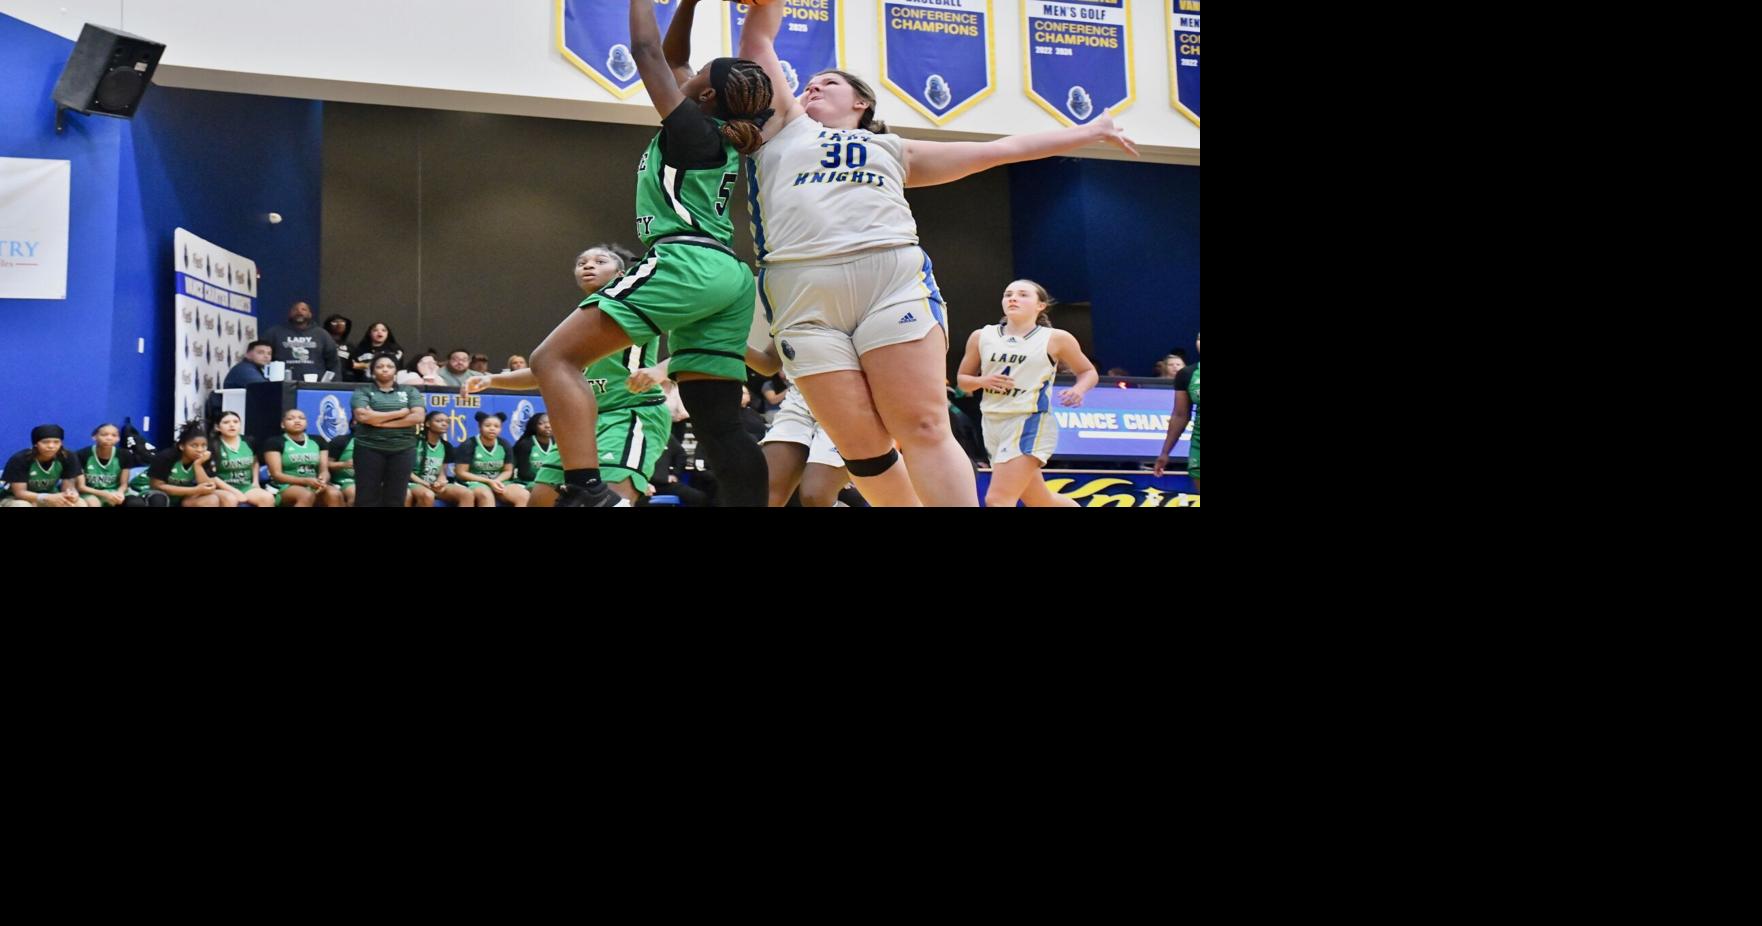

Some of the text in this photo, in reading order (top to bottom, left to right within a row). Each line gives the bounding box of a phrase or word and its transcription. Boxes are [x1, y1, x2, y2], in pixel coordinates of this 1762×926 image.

[891, 7, 977, 24] CONFERENCE
[1043, 5, 1106, 20] MEN'S GOLF
[891, 18, 979, 37] CHAMPIONS
[1034, 20, 1117, 37] CONFERENCE
[1034, 32, 1118, 48] CHAMPIONS
[820, 142, 867, 169] 30
[792, 170, 886, 187] KNIGHTS
[715, 171, 738, 218] 5
[990, 352, 1027, 364] LADY
[430, 395, 450, 407] OF
[455, 396, 480, 408] THE
[1054, 411, 1119, 430] VANCE
